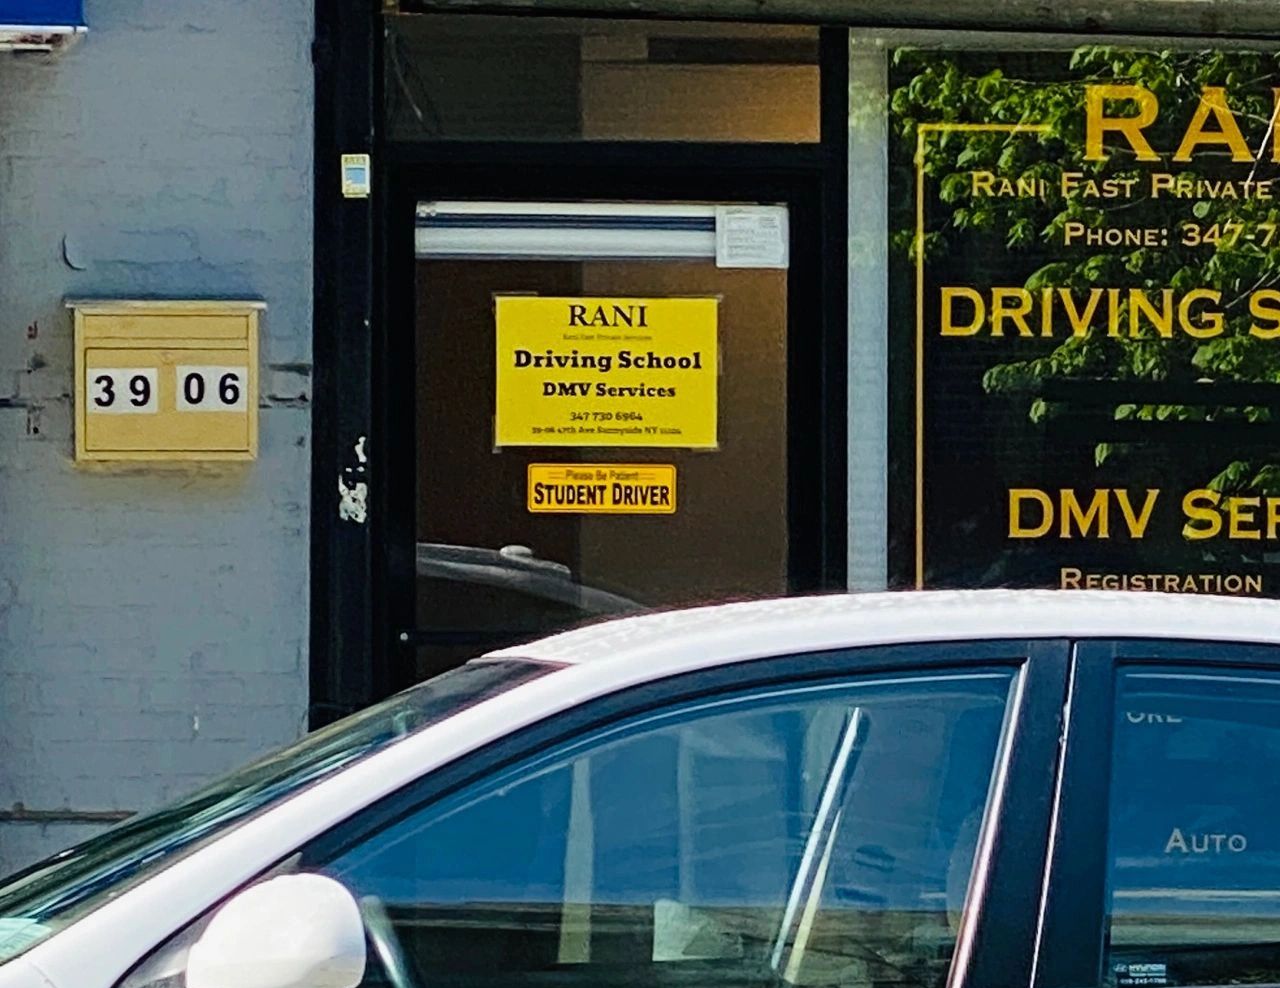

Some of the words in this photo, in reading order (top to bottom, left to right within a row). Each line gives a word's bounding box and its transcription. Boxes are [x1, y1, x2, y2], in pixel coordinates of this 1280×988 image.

[971, 171, 1045, 197] RANI
[1061, 172, 1139, 198] FAST
[1151, 173, 1272, 200] PRIVATE
[1064, 222, 1168, 246] PHONE:
[569, 305, 648, 327] RANI
[940, 287, 1223, 340] DRIVING
[514, 350, 612, 372] Driving
[618, 351, 702, 369] School
[93, 374, 151, 407] 39
[183, 372, 240, 405] 06
[542, 382, 591, 396] DMV
[596, 382, 676, 397] Services
[570, 411, 590, 421] 347
[592, 411, 613, 421] 730
[534, 482, 607, 504] STUDENT
[612, 483, 670, 506] DRIVER
[1008, 489, 1159, 538] DMV
[1060, 568, 1263, 592] REGISTRATION
[1165, 827, 1247, 852] AUTO
